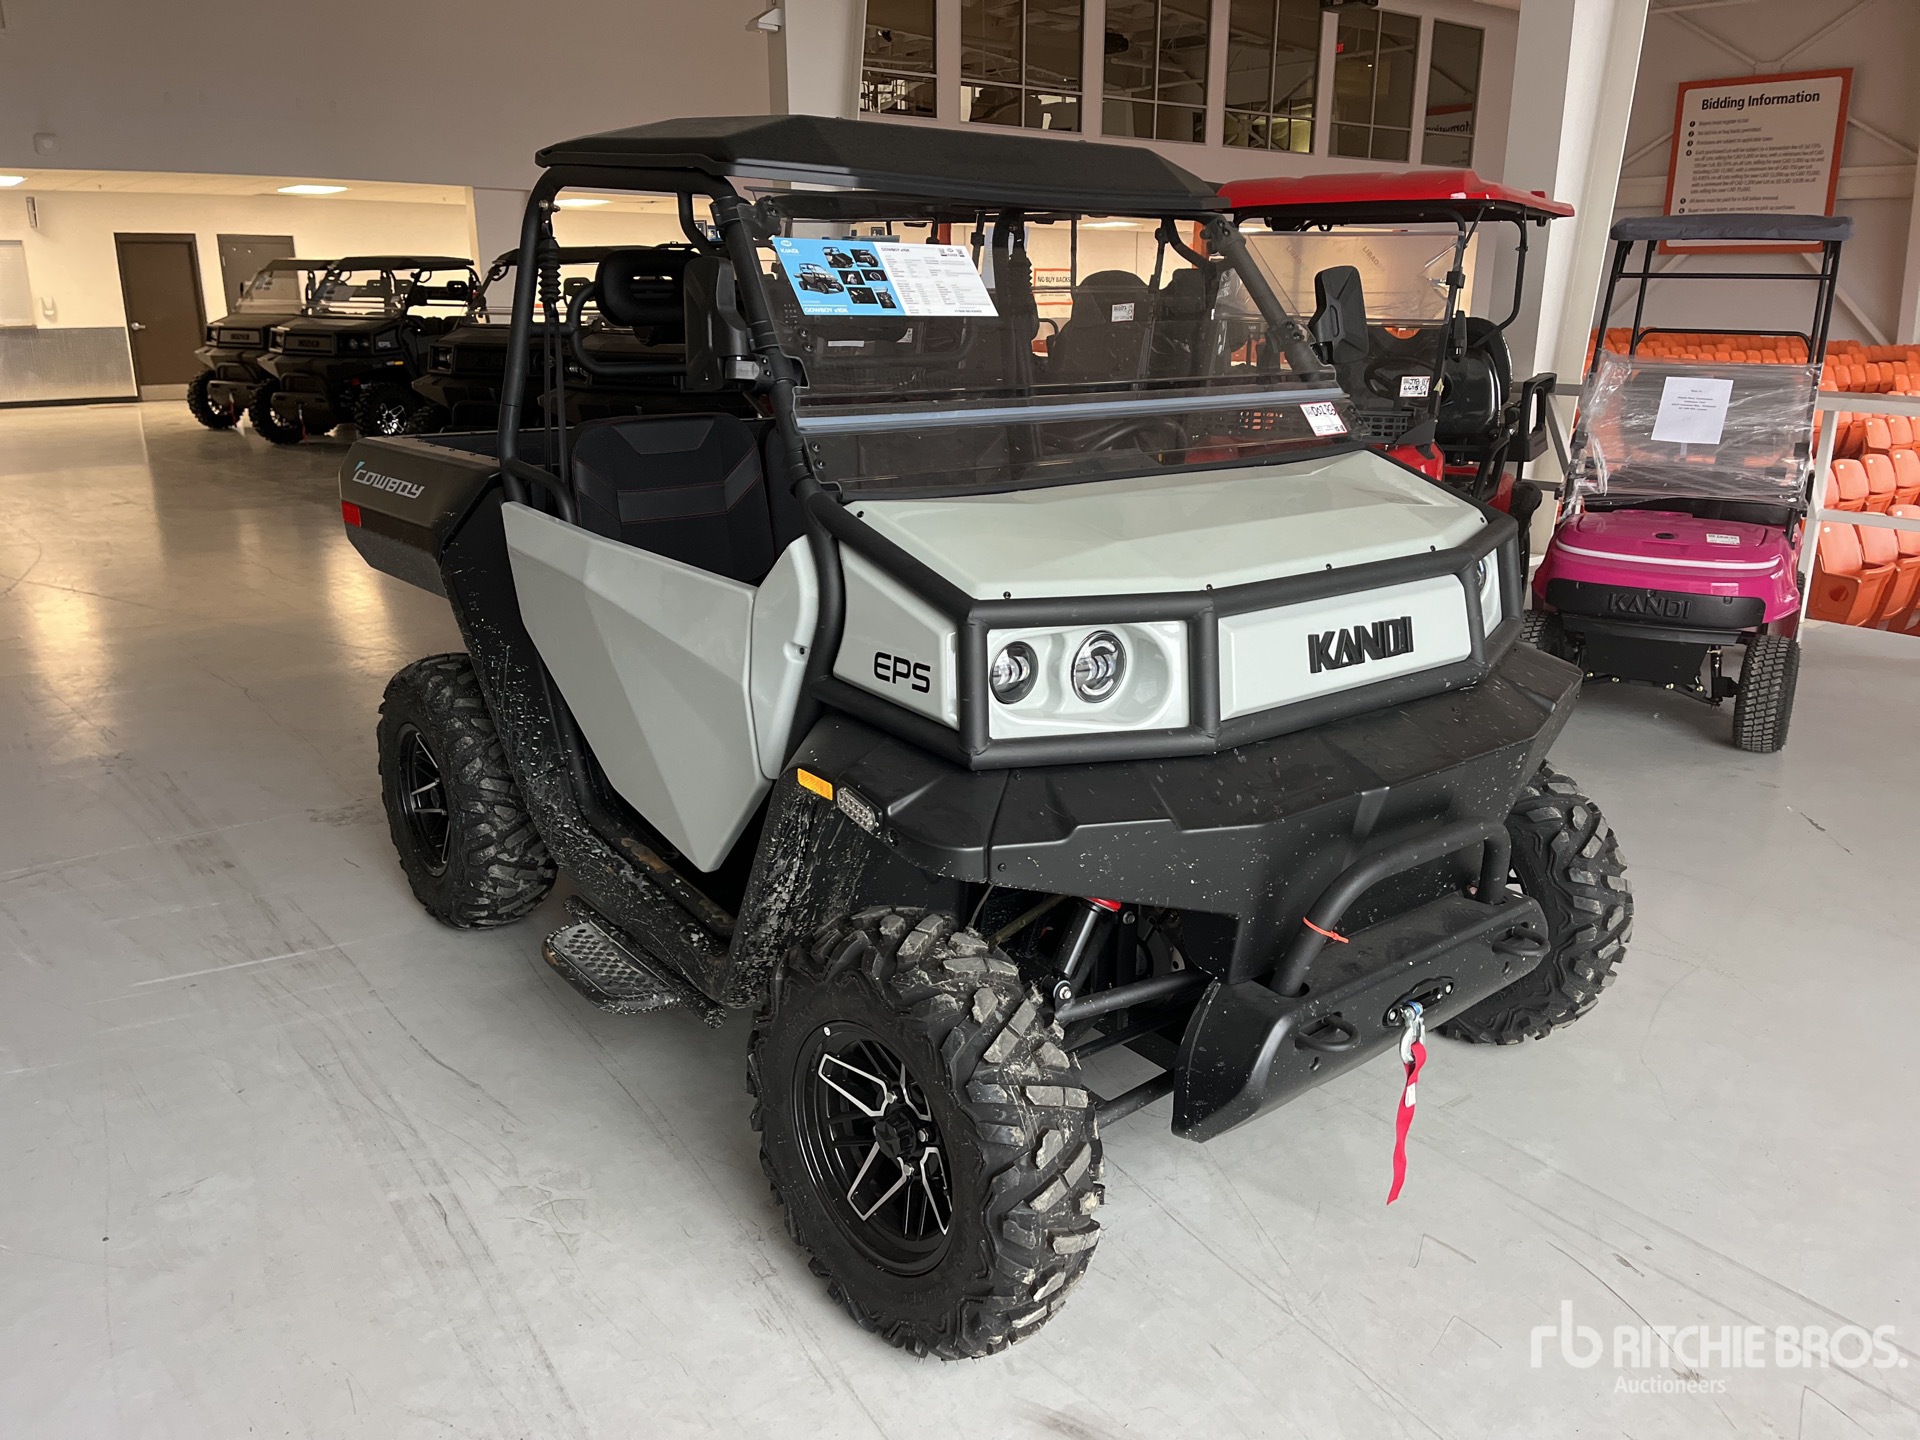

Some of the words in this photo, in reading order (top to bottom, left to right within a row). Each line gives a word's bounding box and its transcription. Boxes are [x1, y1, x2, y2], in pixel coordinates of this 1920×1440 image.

[1702, 96, 1745, 110] Bidding
[1748, 91, 1820, 106] Information
[352, 467, 425, 499] COWBOY
[1608, 592, 1691, 619] KANDI
[1308, 616, 1414, 674] KANDI
[874, 651, 931, 693] EPS
